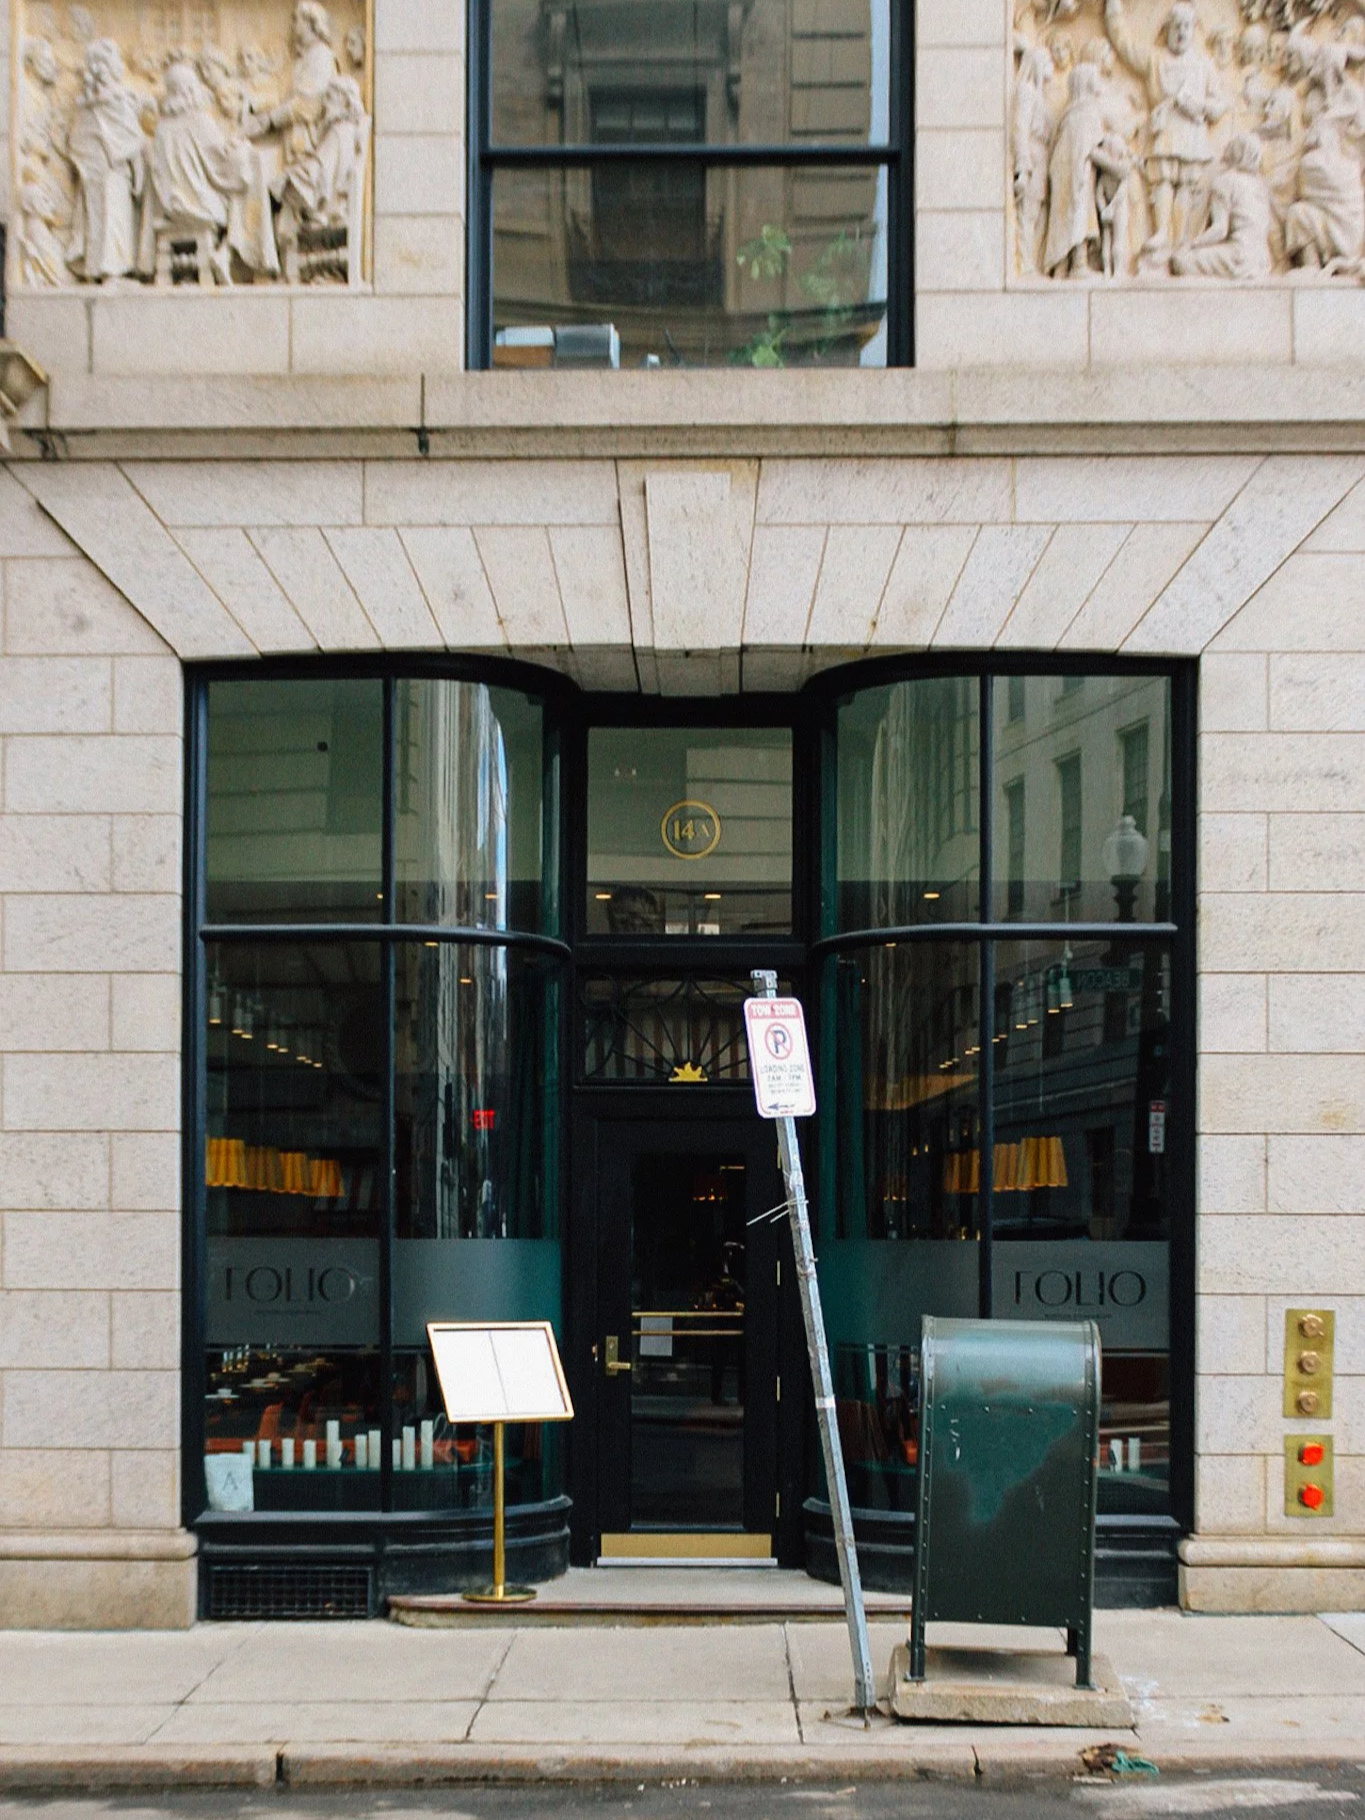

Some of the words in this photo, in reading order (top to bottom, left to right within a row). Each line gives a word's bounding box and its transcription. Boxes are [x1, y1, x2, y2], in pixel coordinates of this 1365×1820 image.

[751, 1004, 770, 1016] TOW
[774, 1003, 796, 1015] ZONE
[760, 1064, 788, 1075] LOADING
[789, 1063, 805, 1074] ZONE
[225, 1266, 356, 1303] FOLIO
[1013, 1270, 1147, 1307] FOLIO
